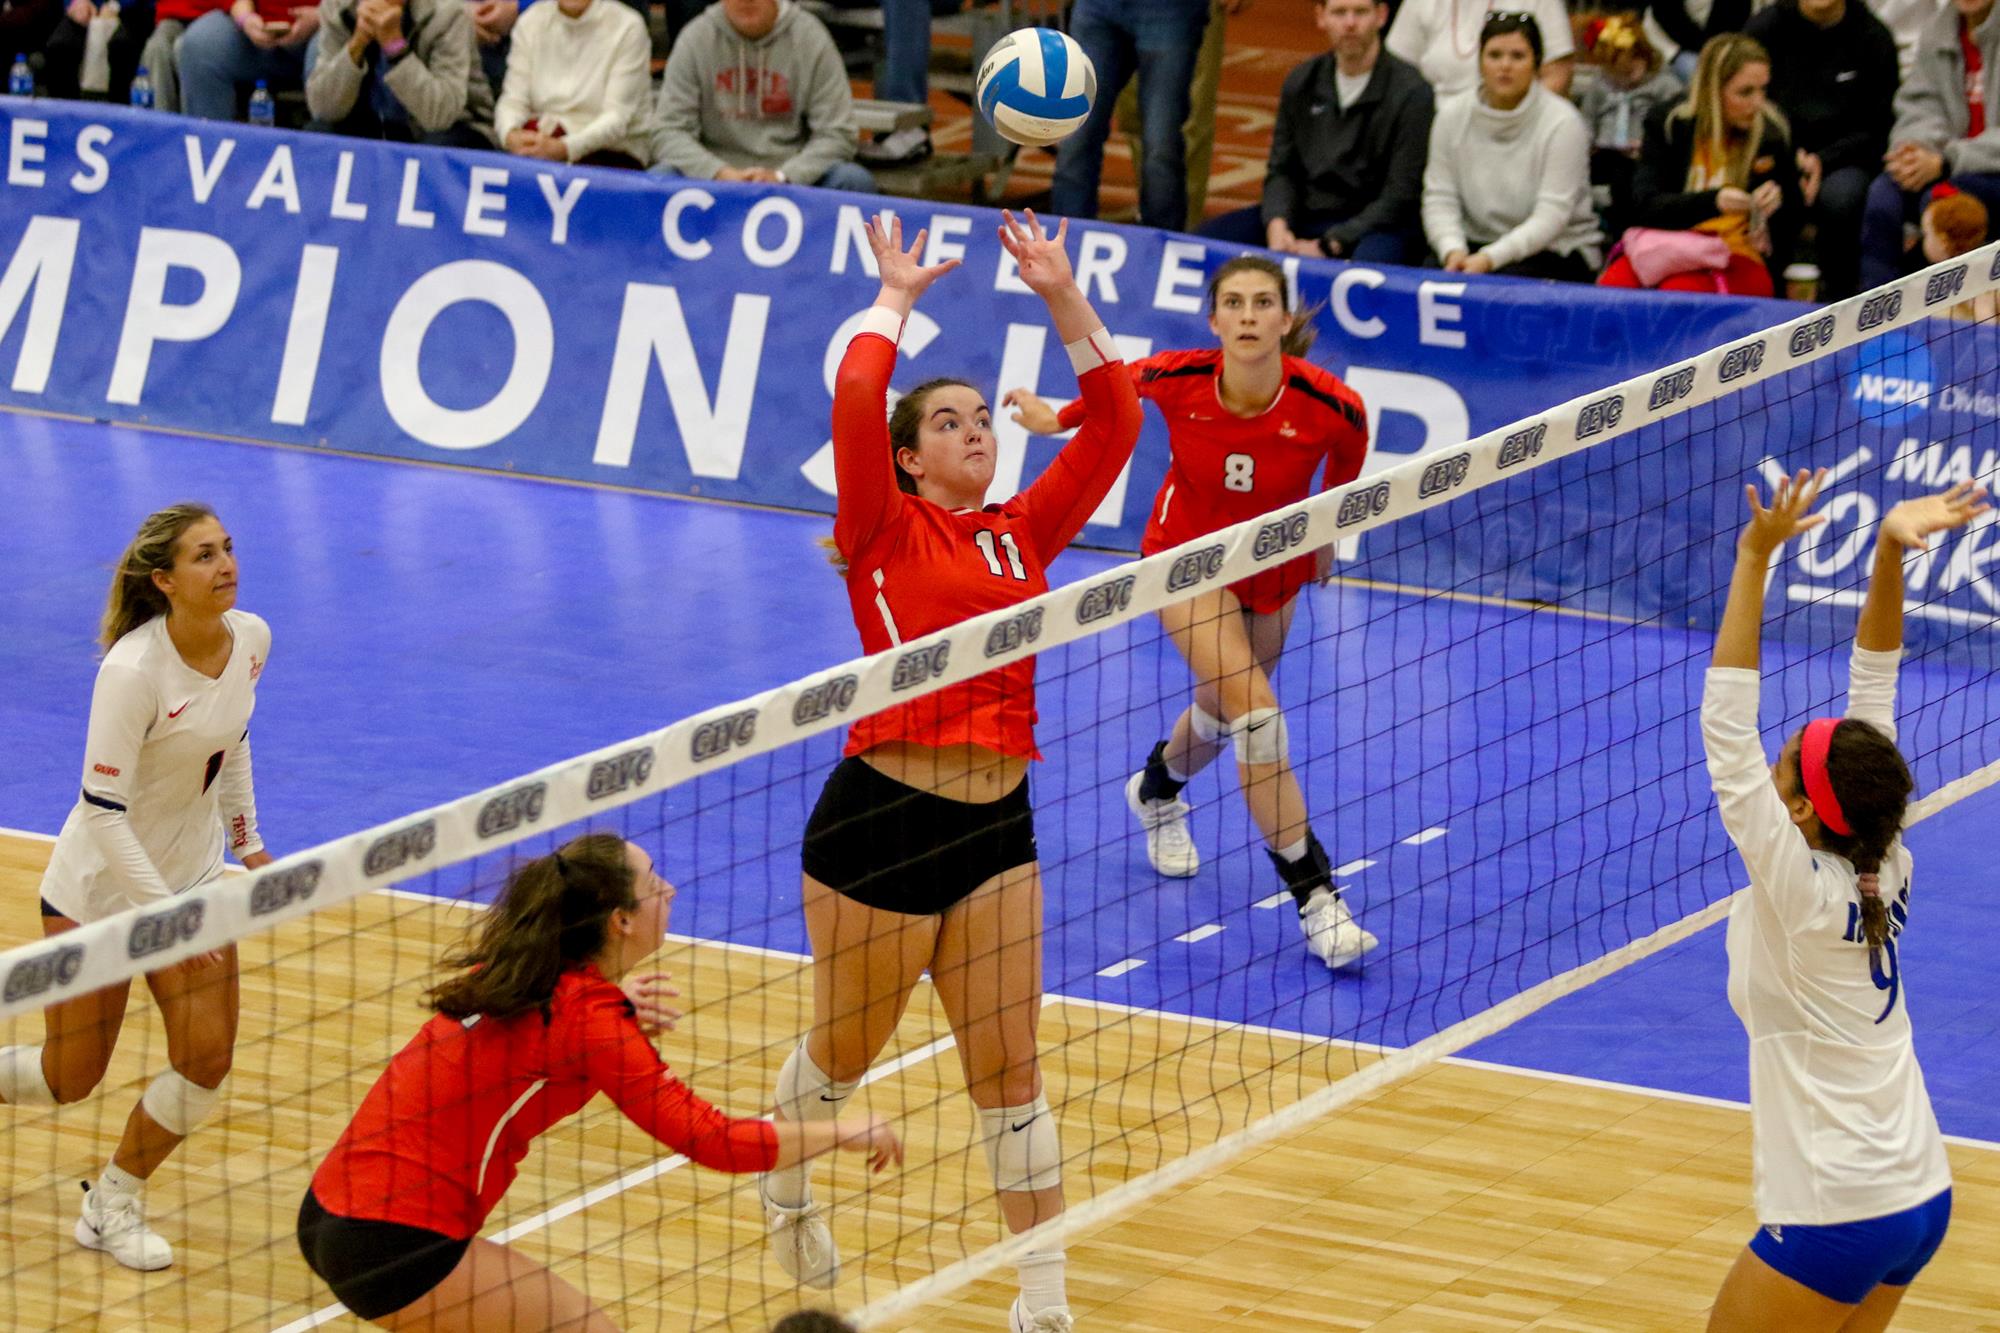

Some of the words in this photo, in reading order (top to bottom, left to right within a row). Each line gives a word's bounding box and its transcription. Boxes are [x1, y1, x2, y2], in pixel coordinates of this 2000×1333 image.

[185, 136, 589, 244] VALLEY
[0, 215, 1471, 562] PIONSHP
[1853, 374, 1930, 409] NCAA
[1224, 452, 1254, 493] 8
[587, 746, 655, 800] GLVC
[692, 708, 757, 762] GLVC
[793, 674, 858, 726] GLVC
[1076, 575, 1136, 625] GLVC
[1253, 511, 1309, 560] GLVC
[1337, 481, 1391, 528] GLVC
[1418, 452, 1471, 499] GLVC
[1497, 423, 1547, 469] GLVC
[1719, 340, 1766, 383] GLVC
[1857, 290, 1903, 331] GLVC
[975, 529, 1028, 581] 11
[1869, 934, 1898, 1025] 9
